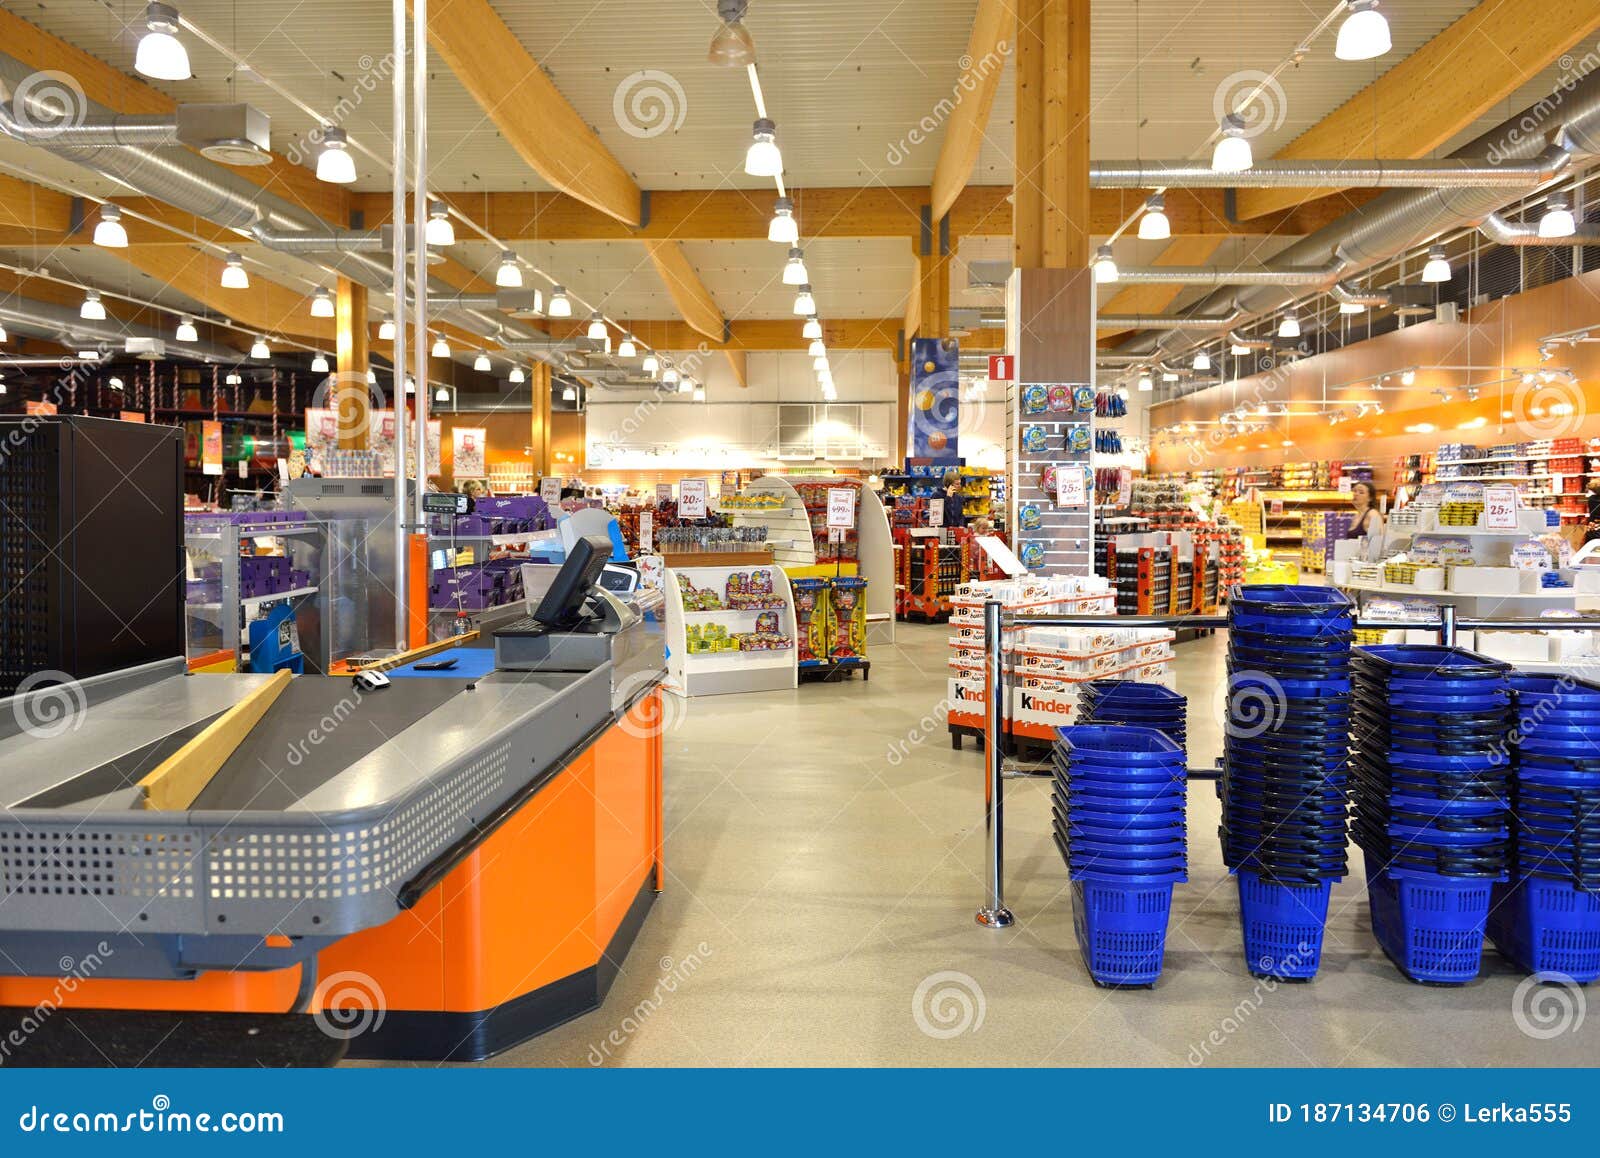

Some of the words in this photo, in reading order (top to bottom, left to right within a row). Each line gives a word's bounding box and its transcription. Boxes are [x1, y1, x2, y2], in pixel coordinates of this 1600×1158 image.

[1061, 483, 1081, 494] 25:-
[683, 494, 702, 504] 20:-
[1490, 505, 1513, 515] 25:-
[960, 587, 970, 595] 16
[958, 607, 968, 615] 16
[960, 628, 971, 637] 16
[958, 649, 969, 658] 16
[1026, 656, 1038, 665] 16
[959, 670, 969, 678] 16
[1027, 679, 1038, 687] 16
